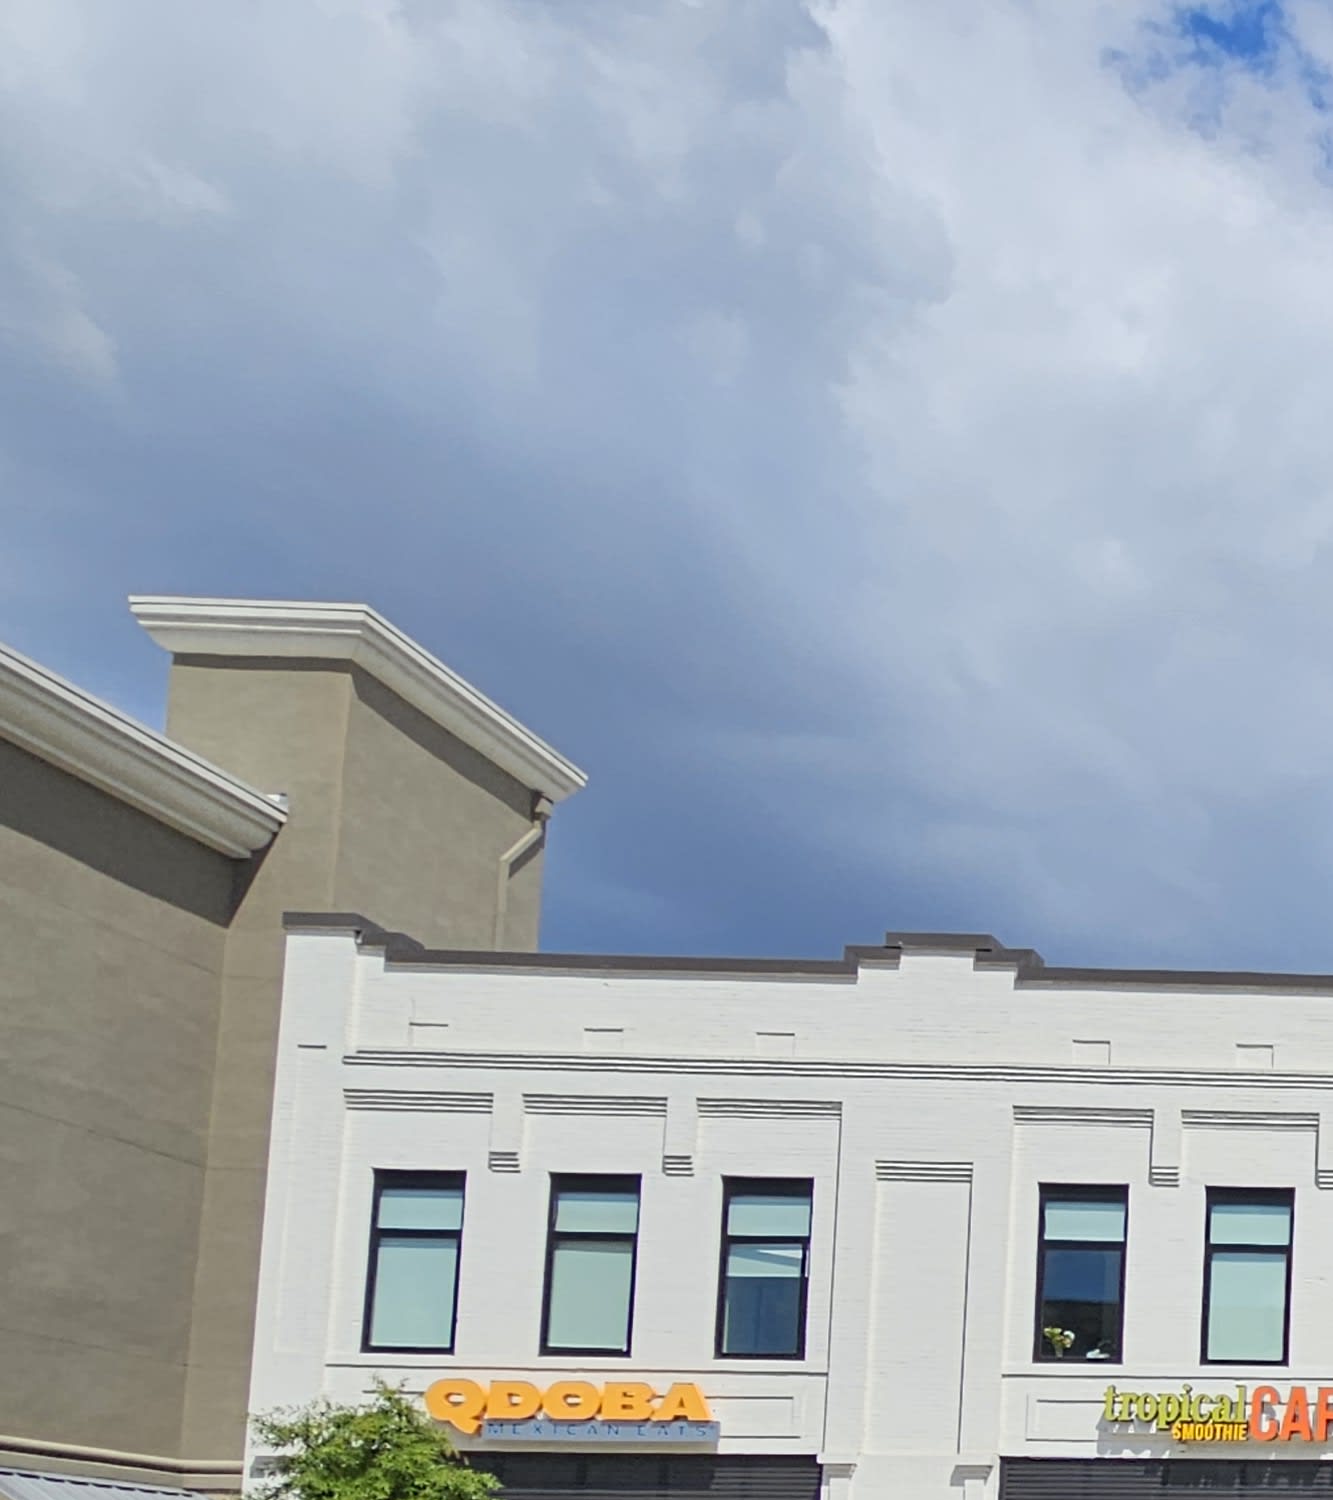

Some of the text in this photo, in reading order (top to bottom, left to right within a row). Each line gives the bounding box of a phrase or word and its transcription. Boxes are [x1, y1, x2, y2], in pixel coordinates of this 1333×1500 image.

[425, 1379, 713, 1434] QDOBA
[1103, 1384, 1247, 1429] tropical
[488, 1423, 707, 1437] MEXICAN EATS
[1172, 1422, 1248, 1442] SMOOTHIE
